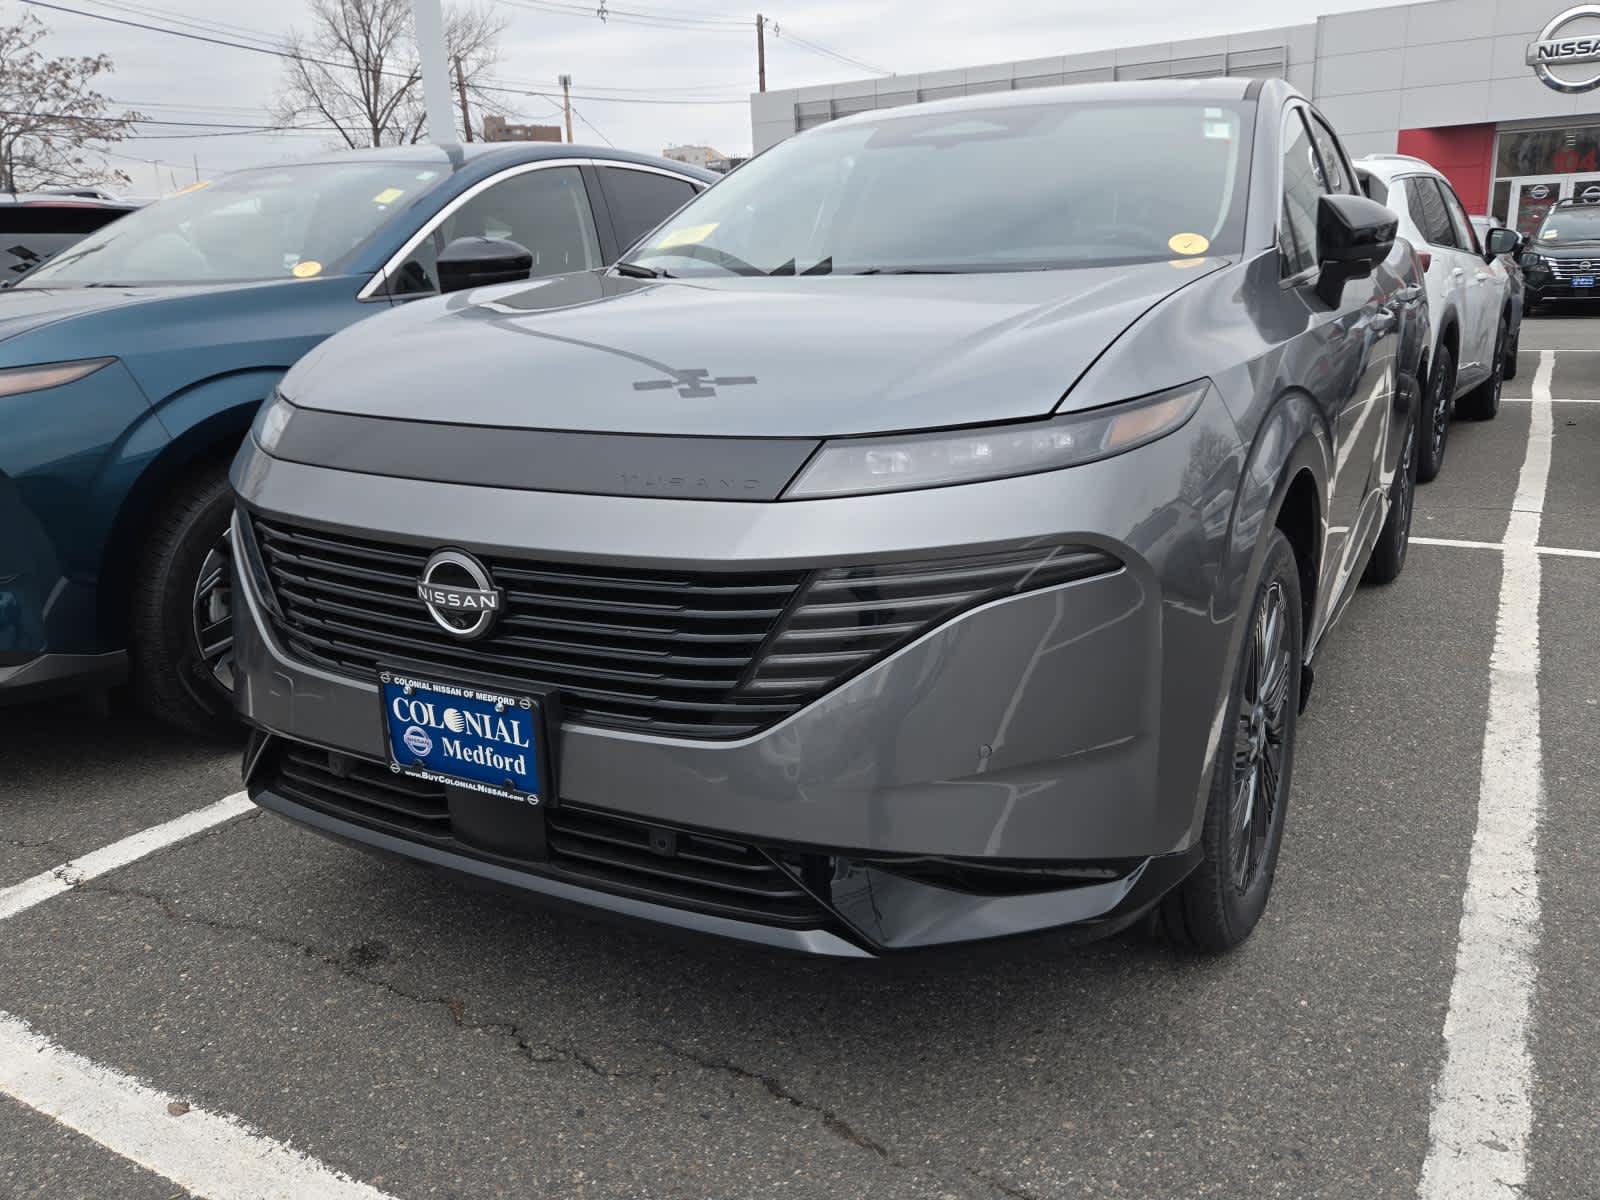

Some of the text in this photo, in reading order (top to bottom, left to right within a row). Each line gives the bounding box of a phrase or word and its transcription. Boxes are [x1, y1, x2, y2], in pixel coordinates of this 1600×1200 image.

[1538, 40, 1600, 58] NISSA
[417, 585, 496, 608] NISSAN
[394, 677, 515, 706] COLONIAL NISSAN OF MEDFORD
[392, 696, 530, 749] COLONIAL
[441, 736, 528, 776] Medford
